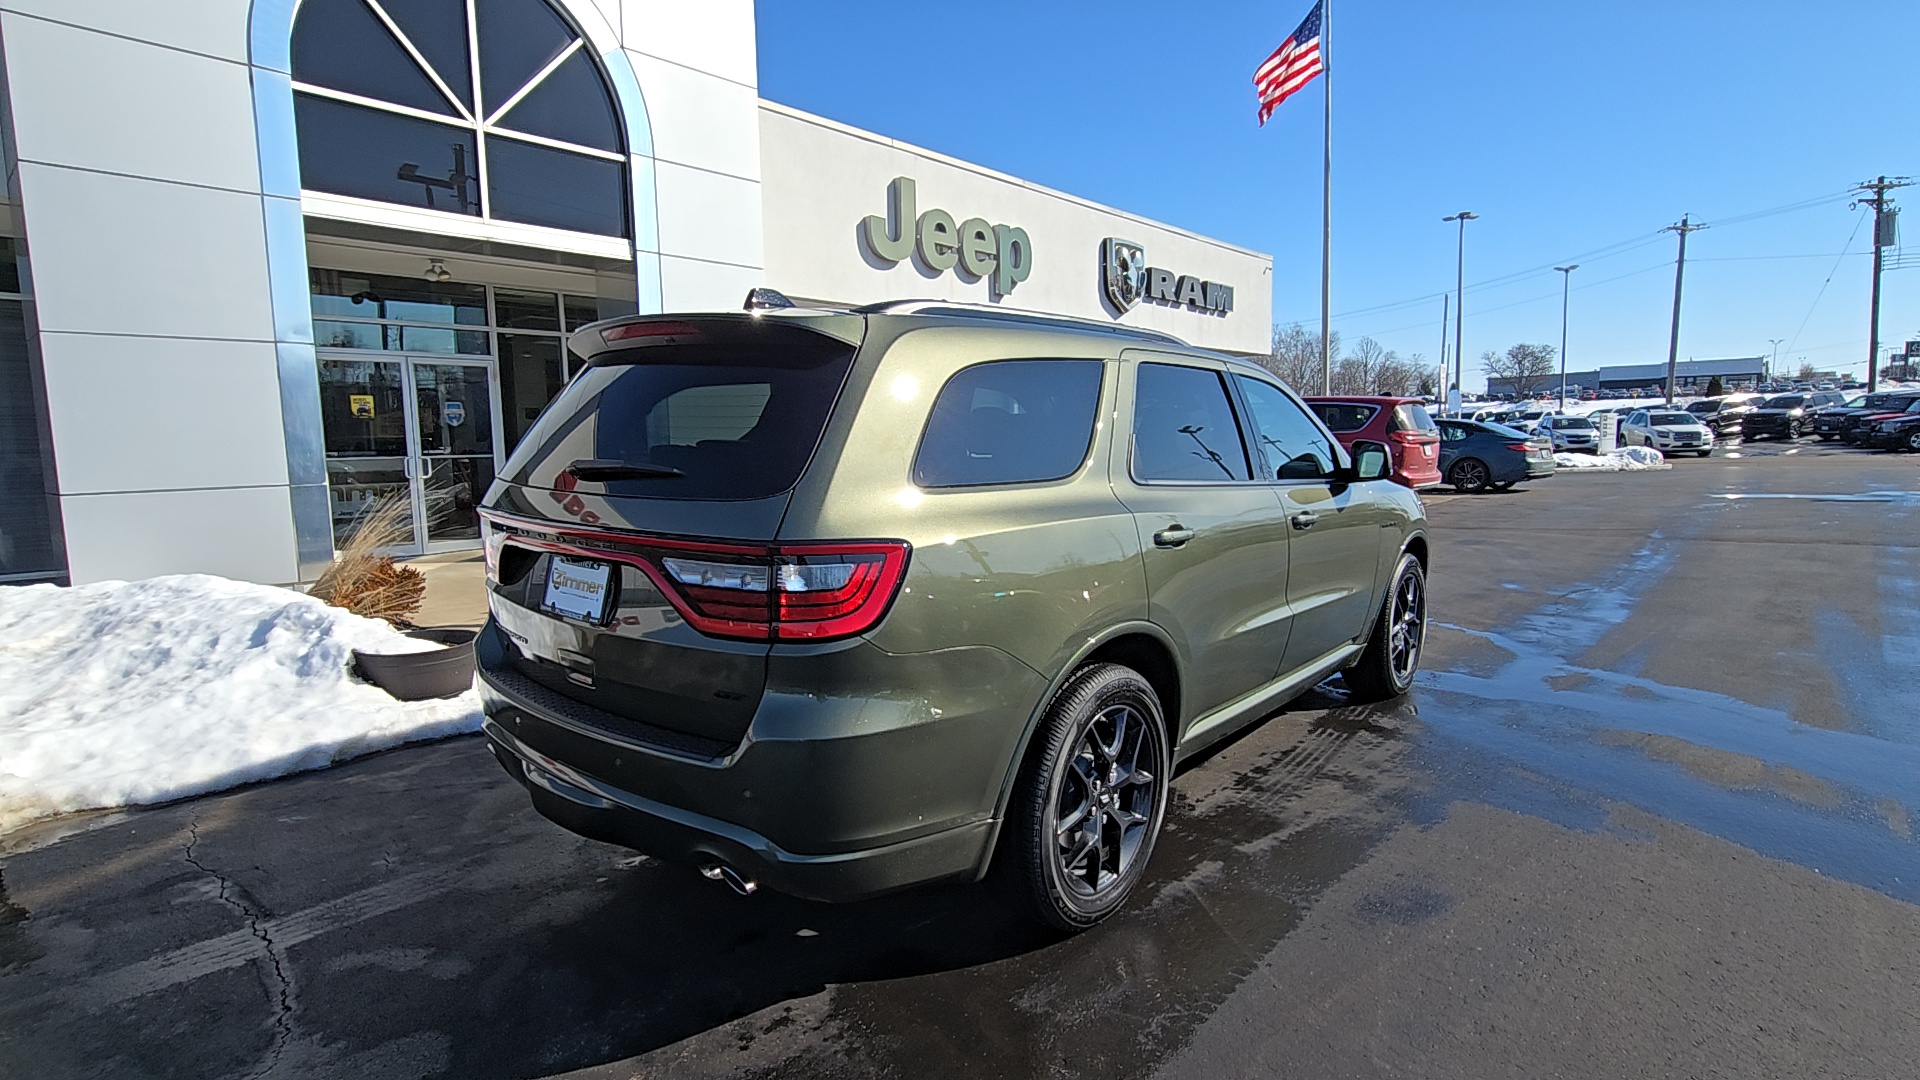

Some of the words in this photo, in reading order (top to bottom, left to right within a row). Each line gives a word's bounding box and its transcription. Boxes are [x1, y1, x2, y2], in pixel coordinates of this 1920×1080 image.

[865, 176, 1032, 295] Jeep
[1146, 267, 1234, 312] RAM
[552, 567, 604, 595] Zimmer
